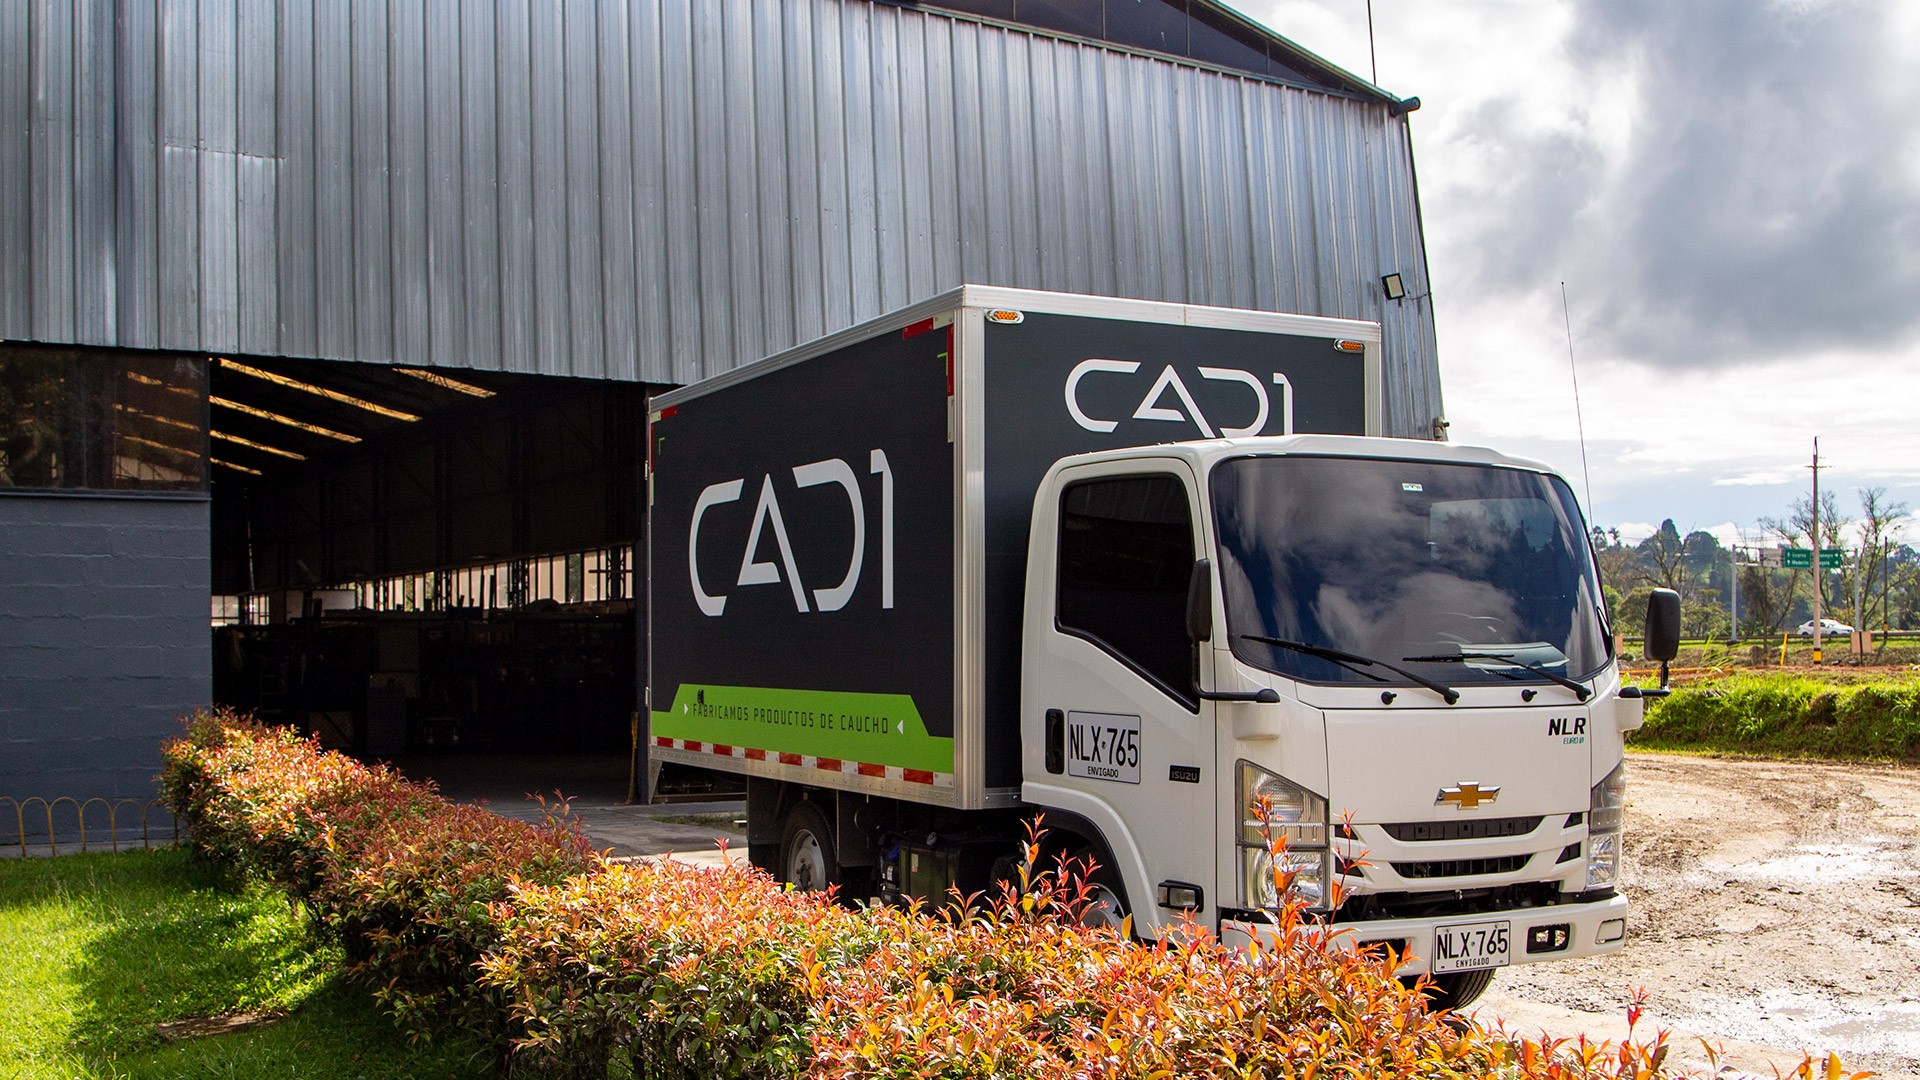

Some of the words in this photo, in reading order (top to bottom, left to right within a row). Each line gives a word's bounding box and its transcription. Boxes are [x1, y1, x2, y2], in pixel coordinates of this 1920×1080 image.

[693, 703, 749, 721] FABRICAMOS
[754, 708, 814, 727] PRODUCTOS
[820, 713, 834, 729] DE
[840, 715, 888, 734] CAUCHO
[1548, 717, 1587, 736] NLR
[1087, 766, 1119, 778] ENVIGADO
[1171, 770, 1198, 781] ISUZU
[1455, 957, 1490, 968] ENVIGADO
